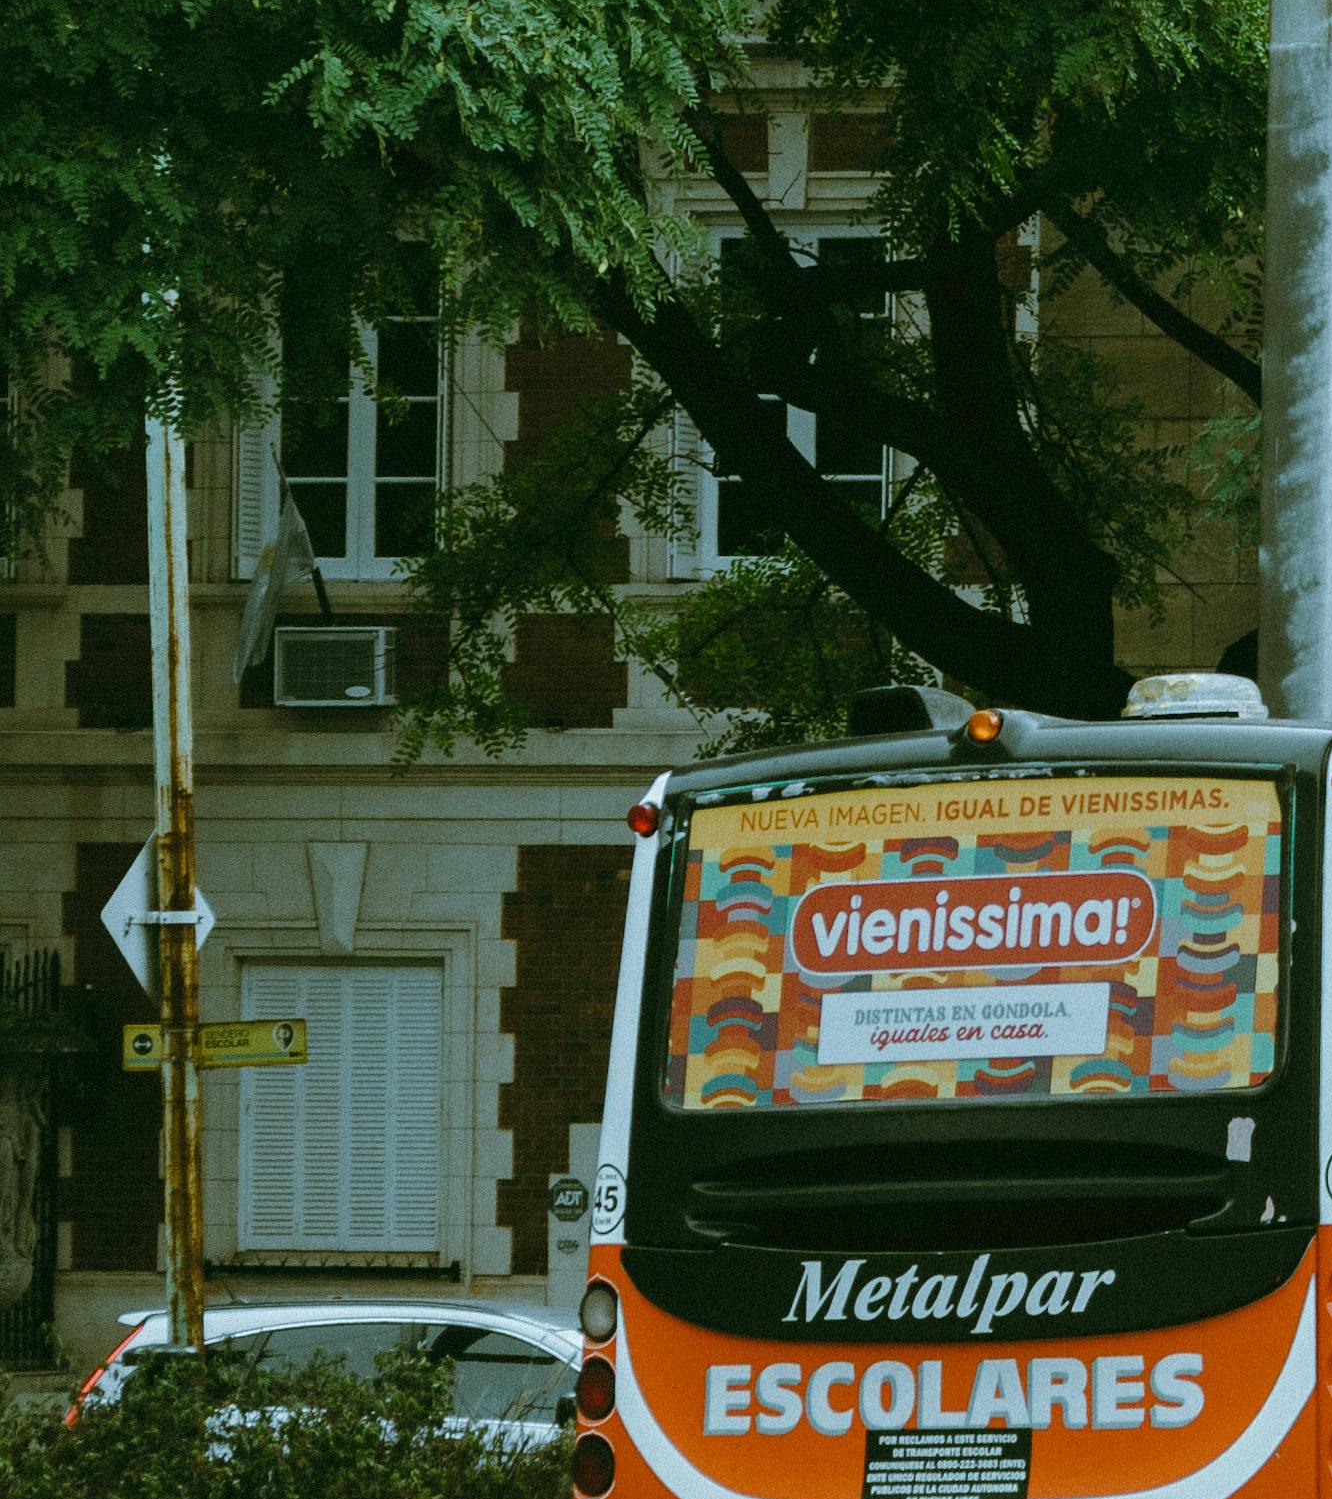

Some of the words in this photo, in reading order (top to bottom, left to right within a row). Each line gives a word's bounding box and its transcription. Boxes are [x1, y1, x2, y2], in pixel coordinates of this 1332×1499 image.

[740, 807, 818, 832] NUEVA
[828, 803, 926, 828] IMAGEN.
[936, 798, 1009, 822] IGUAL
[1019, 796, 1050, 818] DE
[1062, 788, 1229, 815] VIENISSIMAS.
[855, 1005, 946, 1025] DISTINTAS
[952, 1004, 976, 1021] EN
[205, 1039, 249, 1049] ESCOLAR
[870, 1023, 949, 1050] iguales
[957, 1025, 984, 1041] en
[991, 1023, 1048, 1039] casa.
[555, 1190, 582, 1206] ADT
[594, 1185, 618, 1213] 45
[782, 1253, 1116, 1334] Metalpar
[703, 1352, 1205, 1436] ESCOLARES
[879, 1435, 897, 1445] POR
[899, 1435, 945, 1444] RECLAMOS
[946, 1434, 953, 1444] A
[976, 1433, 1018, 1443] SERVICIO
[892, 1447, 904, 1458] DE
[905, 1447, 960, 1457] TRANSPORTE
[962, 1446, 1002, 1456] ESCOLAR
